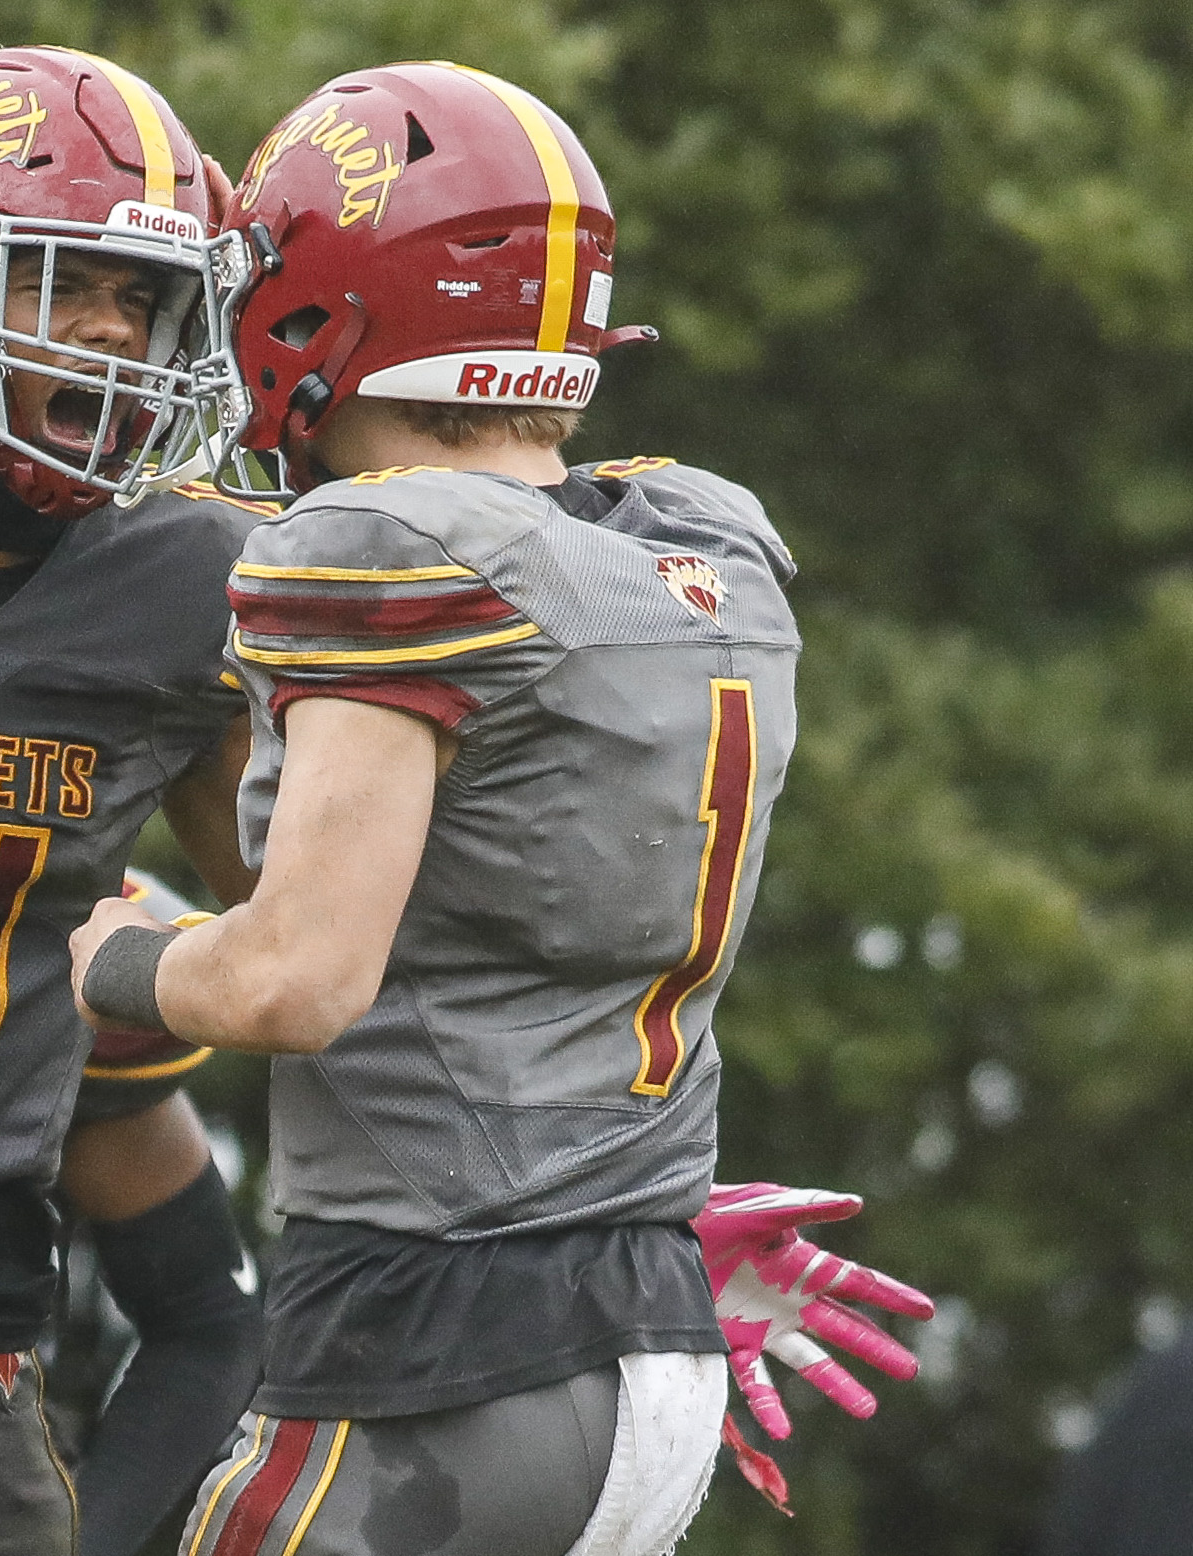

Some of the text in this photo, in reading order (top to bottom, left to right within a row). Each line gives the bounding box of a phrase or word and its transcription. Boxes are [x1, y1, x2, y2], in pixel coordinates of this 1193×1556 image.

[127, 207, 197, 241] Riddell
[436, 280, 481, 292] Riddell
[456, 362, 596, 404] Riddell
[629, 677, 757, 1098] 1
